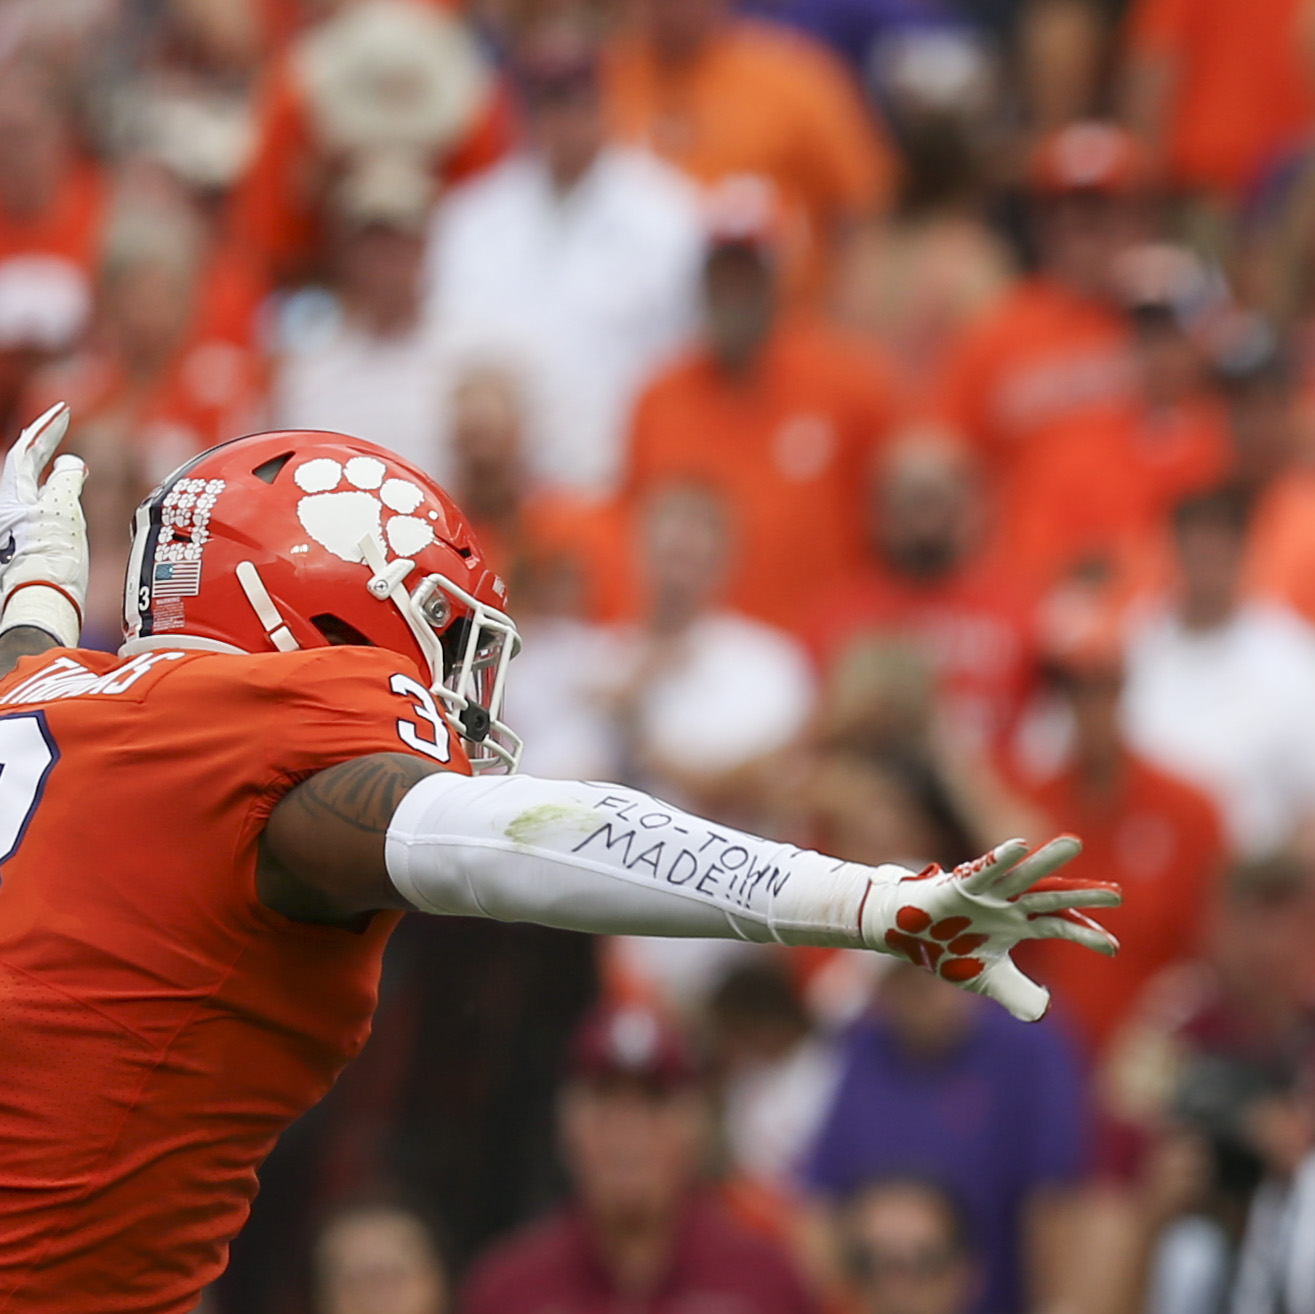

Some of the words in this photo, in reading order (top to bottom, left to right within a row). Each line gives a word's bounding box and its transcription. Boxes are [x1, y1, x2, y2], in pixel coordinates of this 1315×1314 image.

[138, 585, 151, 612] 3
[388, 672, 451, 764] 3
[593, 794, 792, 898] FLO-TOWN
